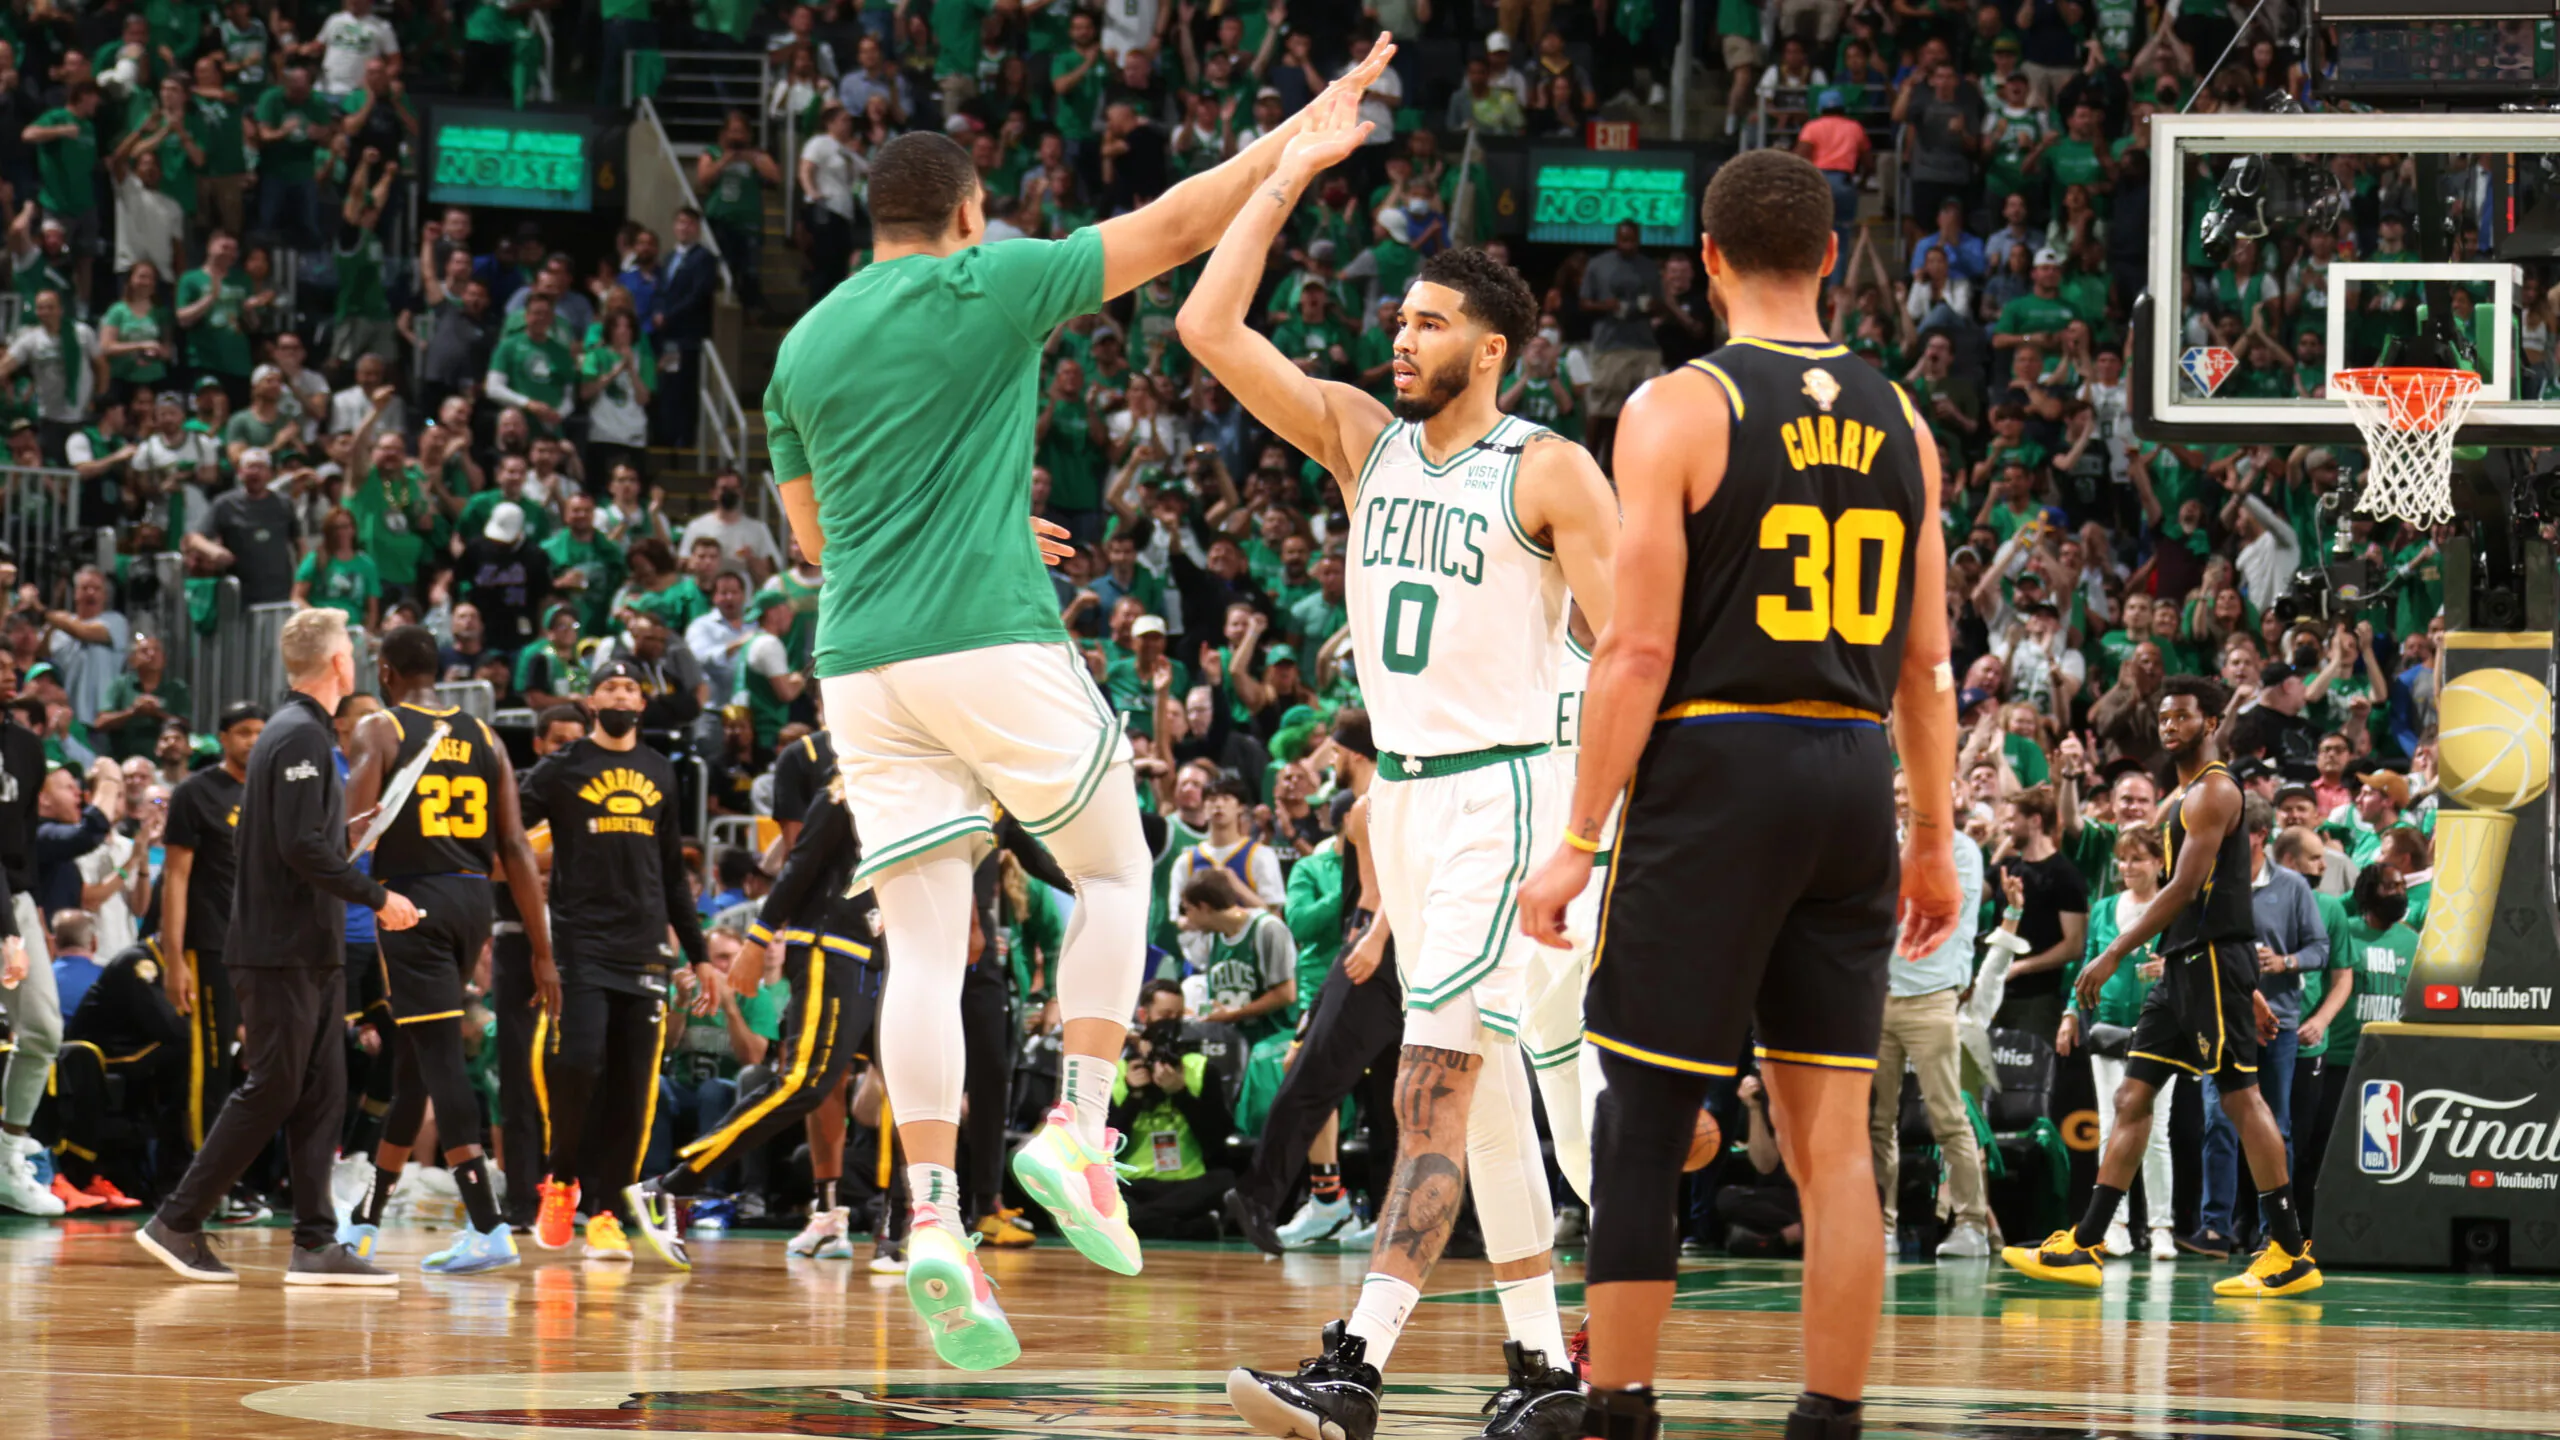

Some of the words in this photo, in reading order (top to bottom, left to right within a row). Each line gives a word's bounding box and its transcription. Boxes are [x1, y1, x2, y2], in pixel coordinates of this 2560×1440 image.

[1595, 124, 1631, 149] EXIT
[1781, 415, 1886, 475] CURRY
[1464, 479, 1496, 491] PRINT
[1468, 465, 1499, 480] VISTA
[1362, 496, 1488, 586] CELTICS
[1756, 503, 1906, 645] 30
[1382, 581, 1439, 676] 0
[577, 767, 663, 807] WARRIORS
[417, 774, 488, 838] 23
[1211, 958, 1257, 992] CELTICS
[2366, 946, 2396, 974] NBA
[2355, 993, 2401, 1022] FINALS
[2365, 1151, 2385, 1168] NBA
[2428, 1172, 2457, 1186] Presented
